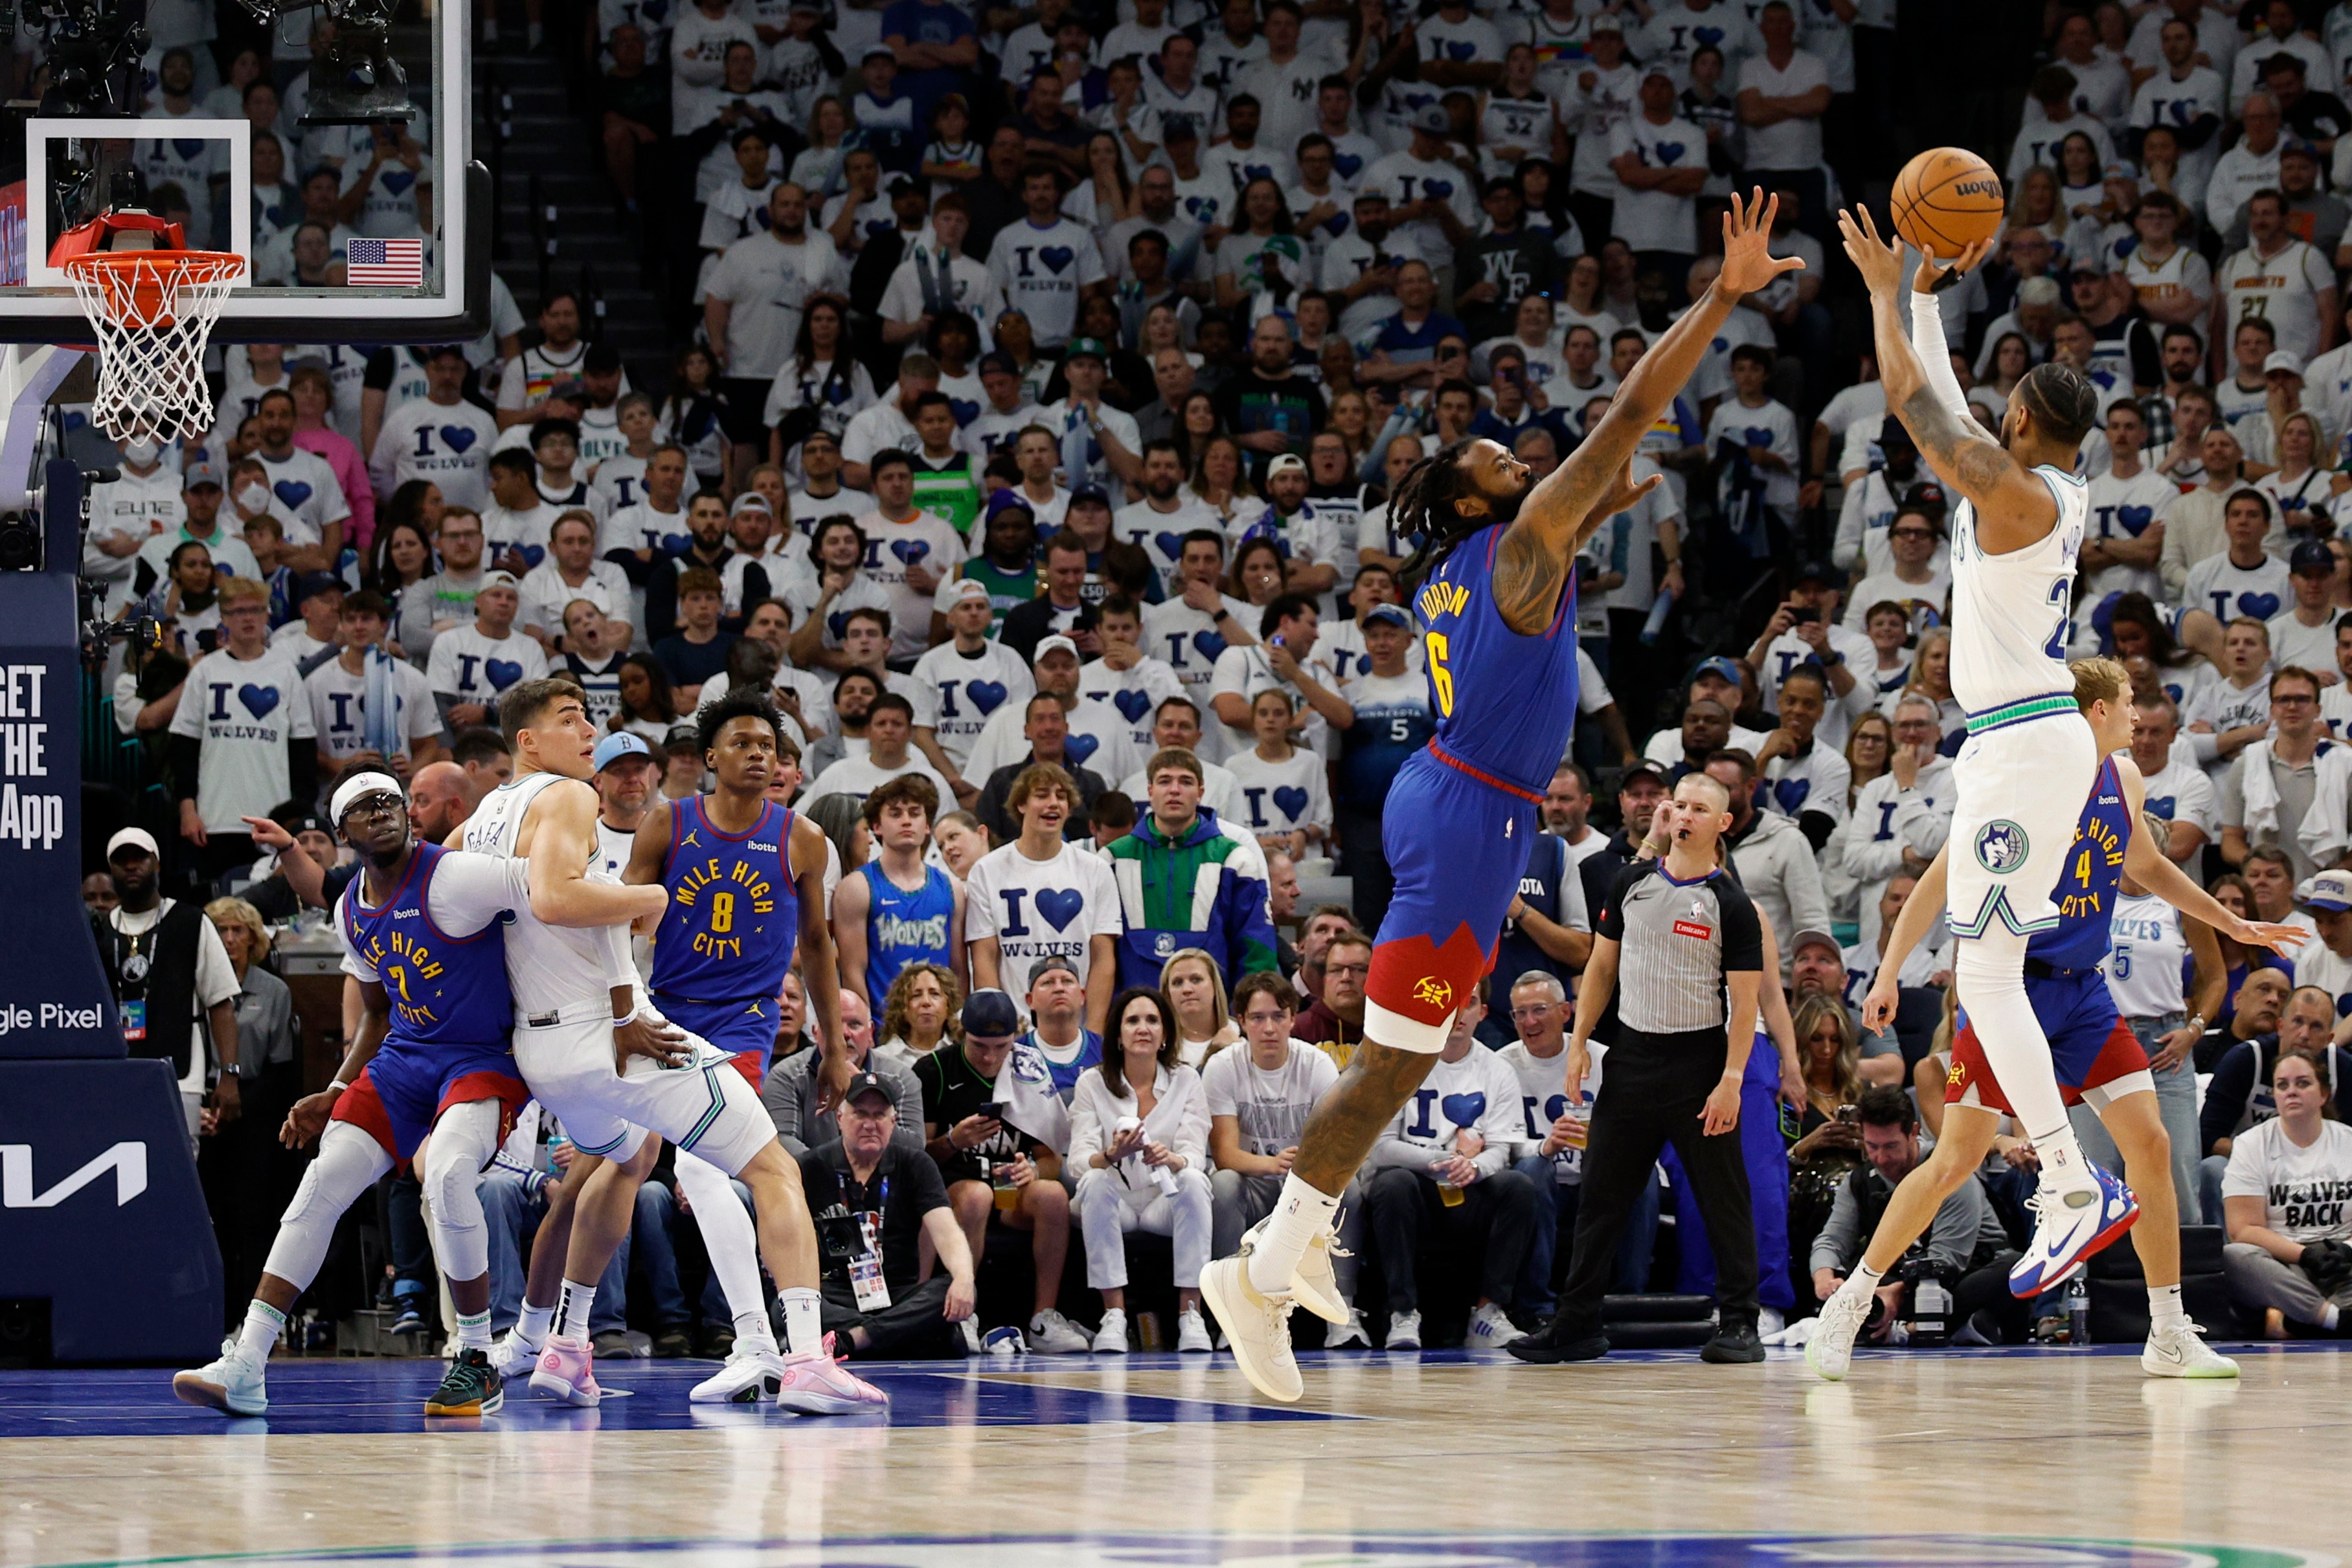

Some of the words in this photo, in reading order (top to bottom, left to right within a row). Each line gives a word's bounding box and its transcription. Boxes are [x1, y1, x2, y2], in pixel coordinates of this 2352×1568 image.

[1015, 247, 1034, 276] I
[414, 427, 435, 456] I
[614, 478, 637, 508] I
[1166, 633, 1189, 667] I
[458, 655, 481, 689] I
[1426, 631, 1454, 719] 6
[209, 682, 232, 721] I
[329, 693, 354, 732] I
[938, 680, 960, 717] I
[209, 726, 277, 743] WOLVES
[1390, 717, 1409, 742] 5
[0, 783, 63, 851] App
[1243, 788, 1268, 827] I
[1874, 801, 1898, 841] I
[747, 840, 777, 853] ibotta
[2089, 817, 2124, 866] HIGH
[676, 858, 722, 907] MILE
[732, 859, 774, 914] HIGH
[2074, 849, 2091, 888] 4
[392, 908, 420, 920] ibotta
[711, 891, 734, 933] 8
[999, 888, 1030, 937] I
[2061, 892, 2101, 918] CITY
[693, 932, 742, 961] CITY
[875, 913, 948, 951] WOLVES
[1675, 923, 1708, 938] Emirates
[391, 932, 444, 980] HIGH
[1002, 941, 1083, 958] WOLVES
[2112, 943, 2133, 981] 5
[388, 965, 412, 1002] 7
[40, 1003, 102, 1028] Pixel
[397, 1001, 438, 1027] CITY
[1408, 1090, 1438, 1139] I
[2286, 1203, 2344, 1228] BACK
